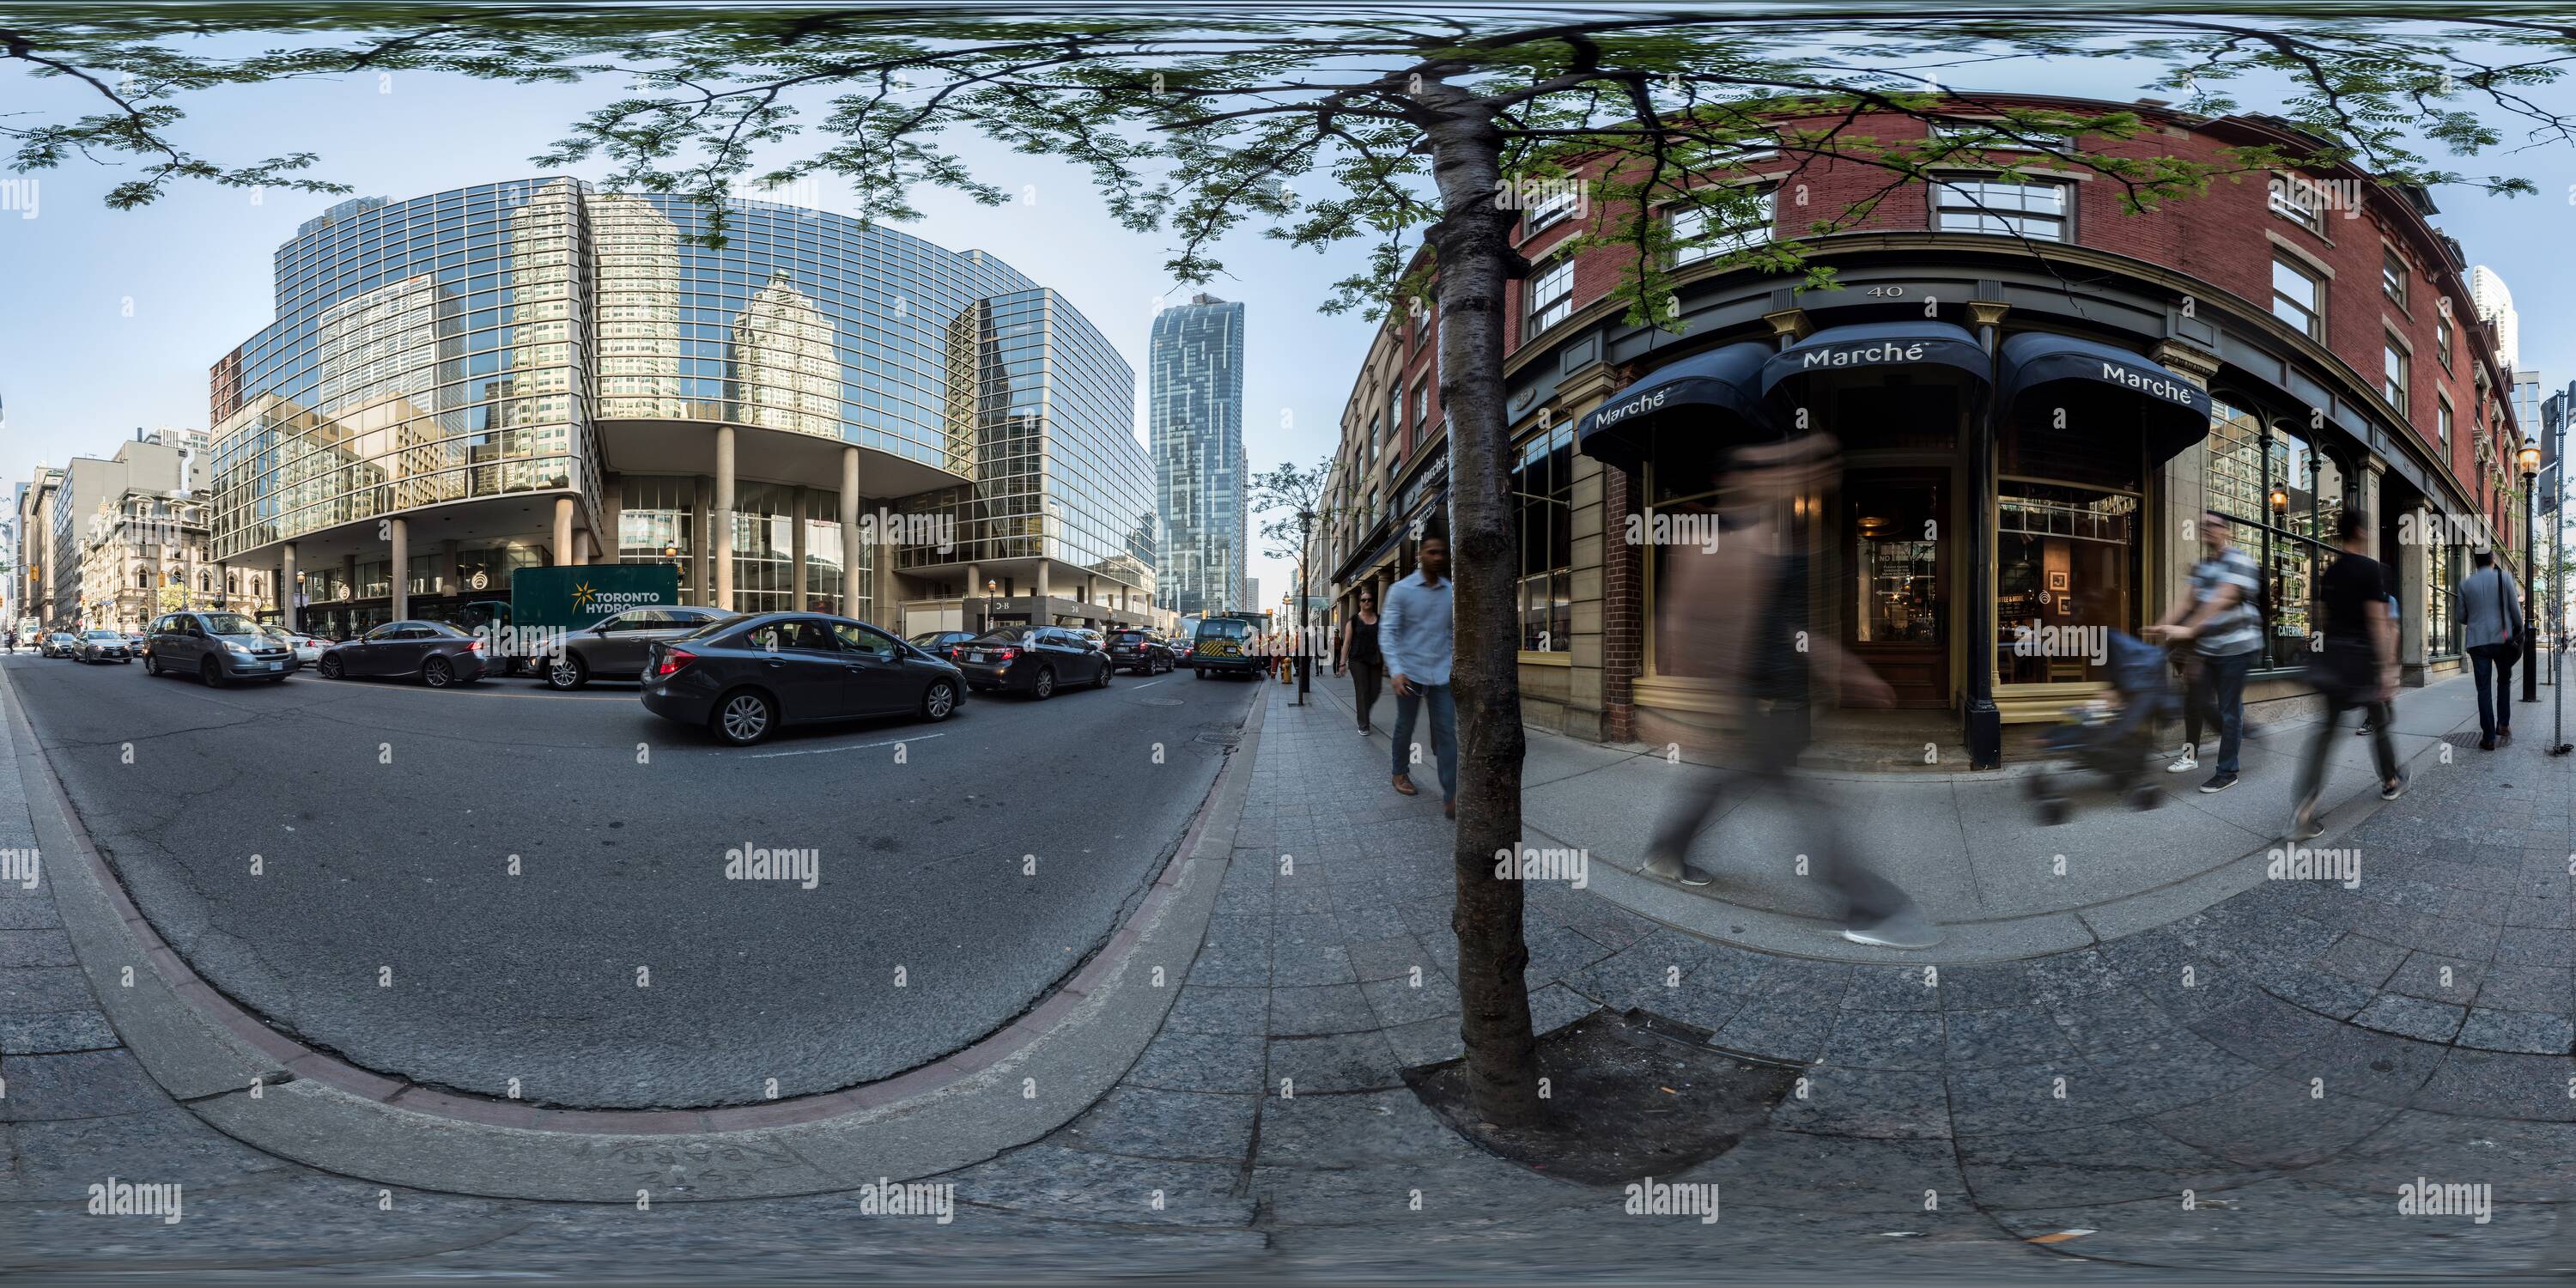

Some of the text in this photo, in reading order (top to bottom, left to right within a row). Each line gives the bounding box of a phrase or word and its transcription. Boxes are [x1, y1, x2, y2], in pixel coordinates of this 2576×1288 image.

[1867, 287, 1904, 297] 40
[595, 592, 659, 603] TORONTO
[586, 604, 632, 614] HYDRO
